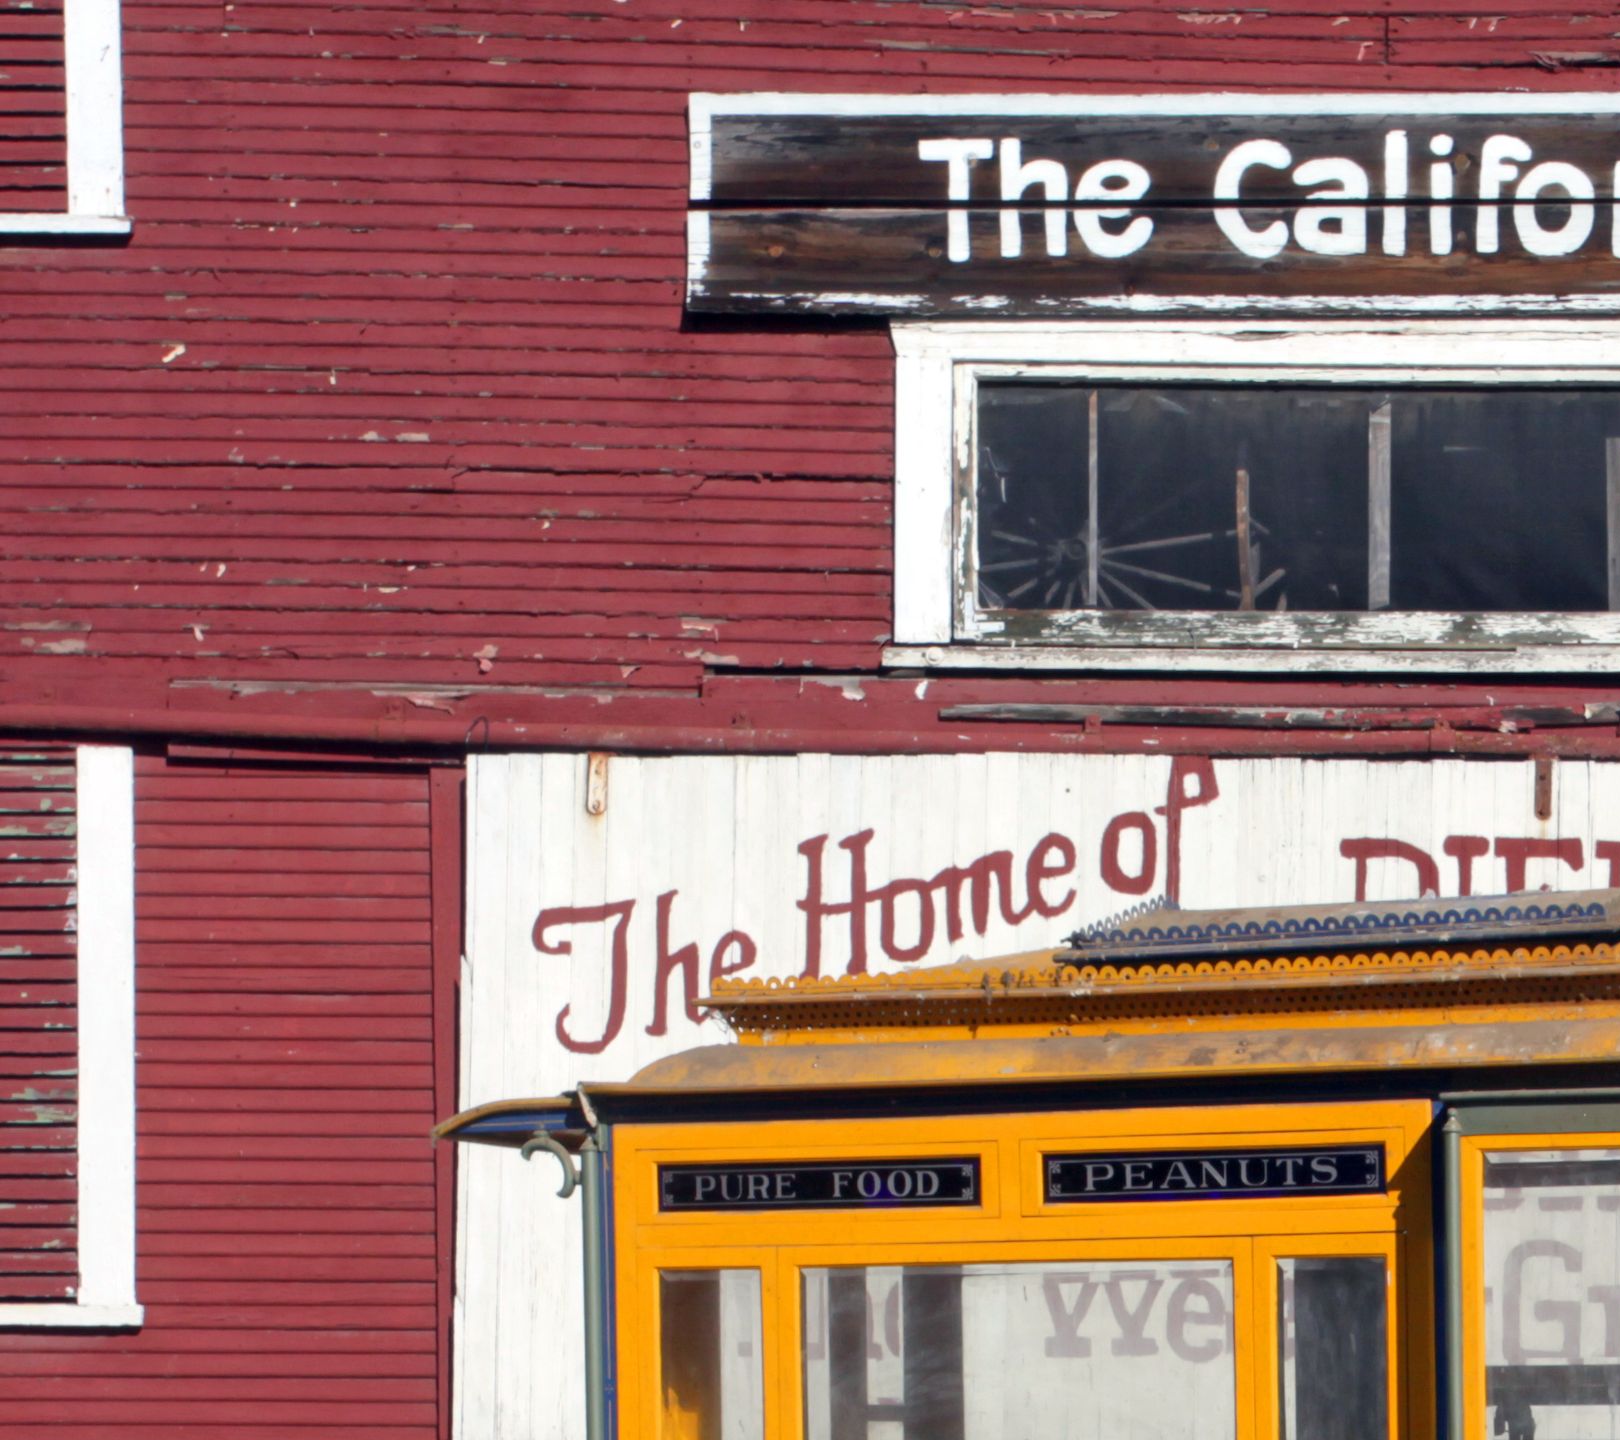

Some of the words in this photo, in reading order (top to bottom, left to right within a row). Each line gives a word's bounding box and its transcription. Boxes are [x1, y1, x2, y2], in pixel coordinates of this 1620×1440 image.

[919, 137, 1153, 263] The
[796, 828, 1077, 978] Home
[693, 1172, 796, 1202] PURE
[832, 1169, 941, 1200] FOOD
[1083, 1155, 1340, 1193] PEANUTS
